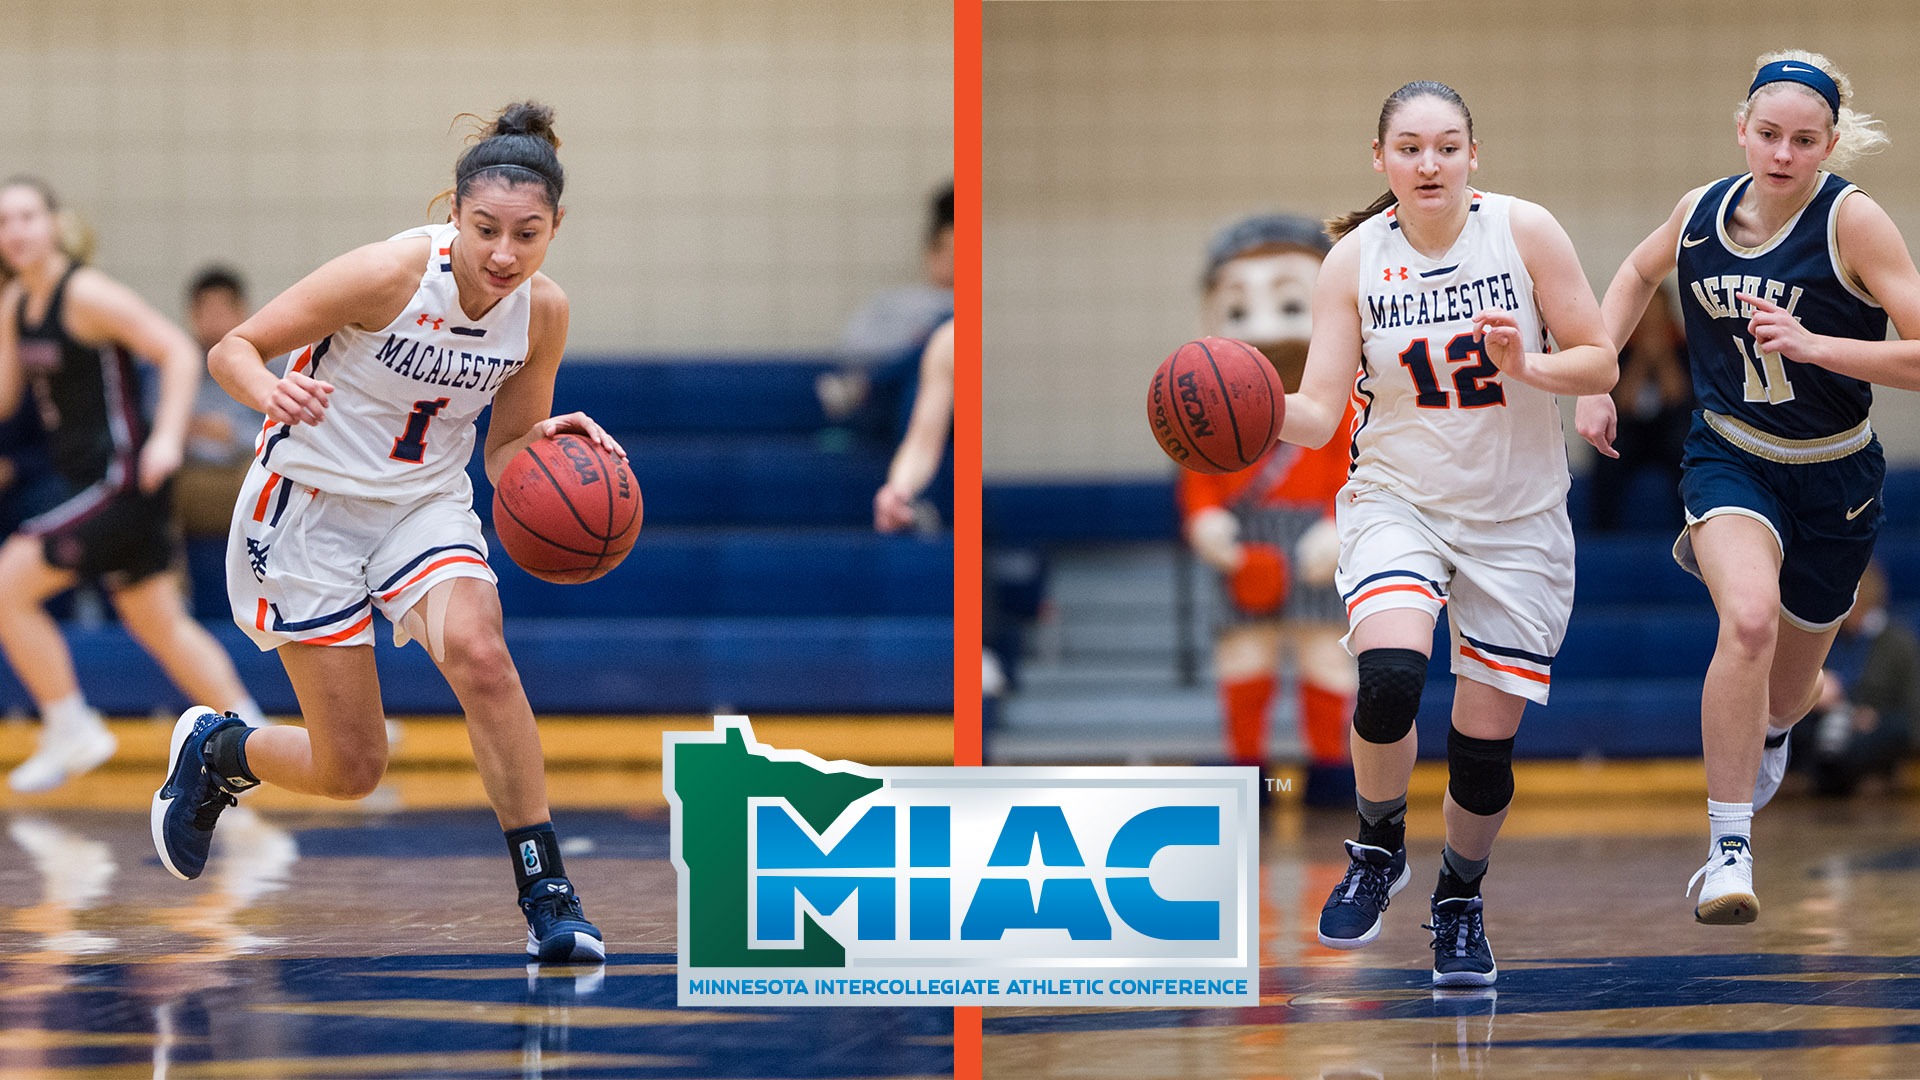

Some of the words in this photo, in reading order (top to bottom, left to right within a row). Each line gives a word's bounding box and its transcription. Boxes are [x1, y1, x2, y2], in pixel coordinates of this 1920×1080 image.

[1367, 273, 1519, 330] MACALESTER
[1398, 330, 1507, 410] 12
[389, 397, 451, 464] 1
[1153, 372, 1190, 461] Wilson
[1177, 371, 1214, 438] NCAA
[556, 436, 600, 486] NCAA
